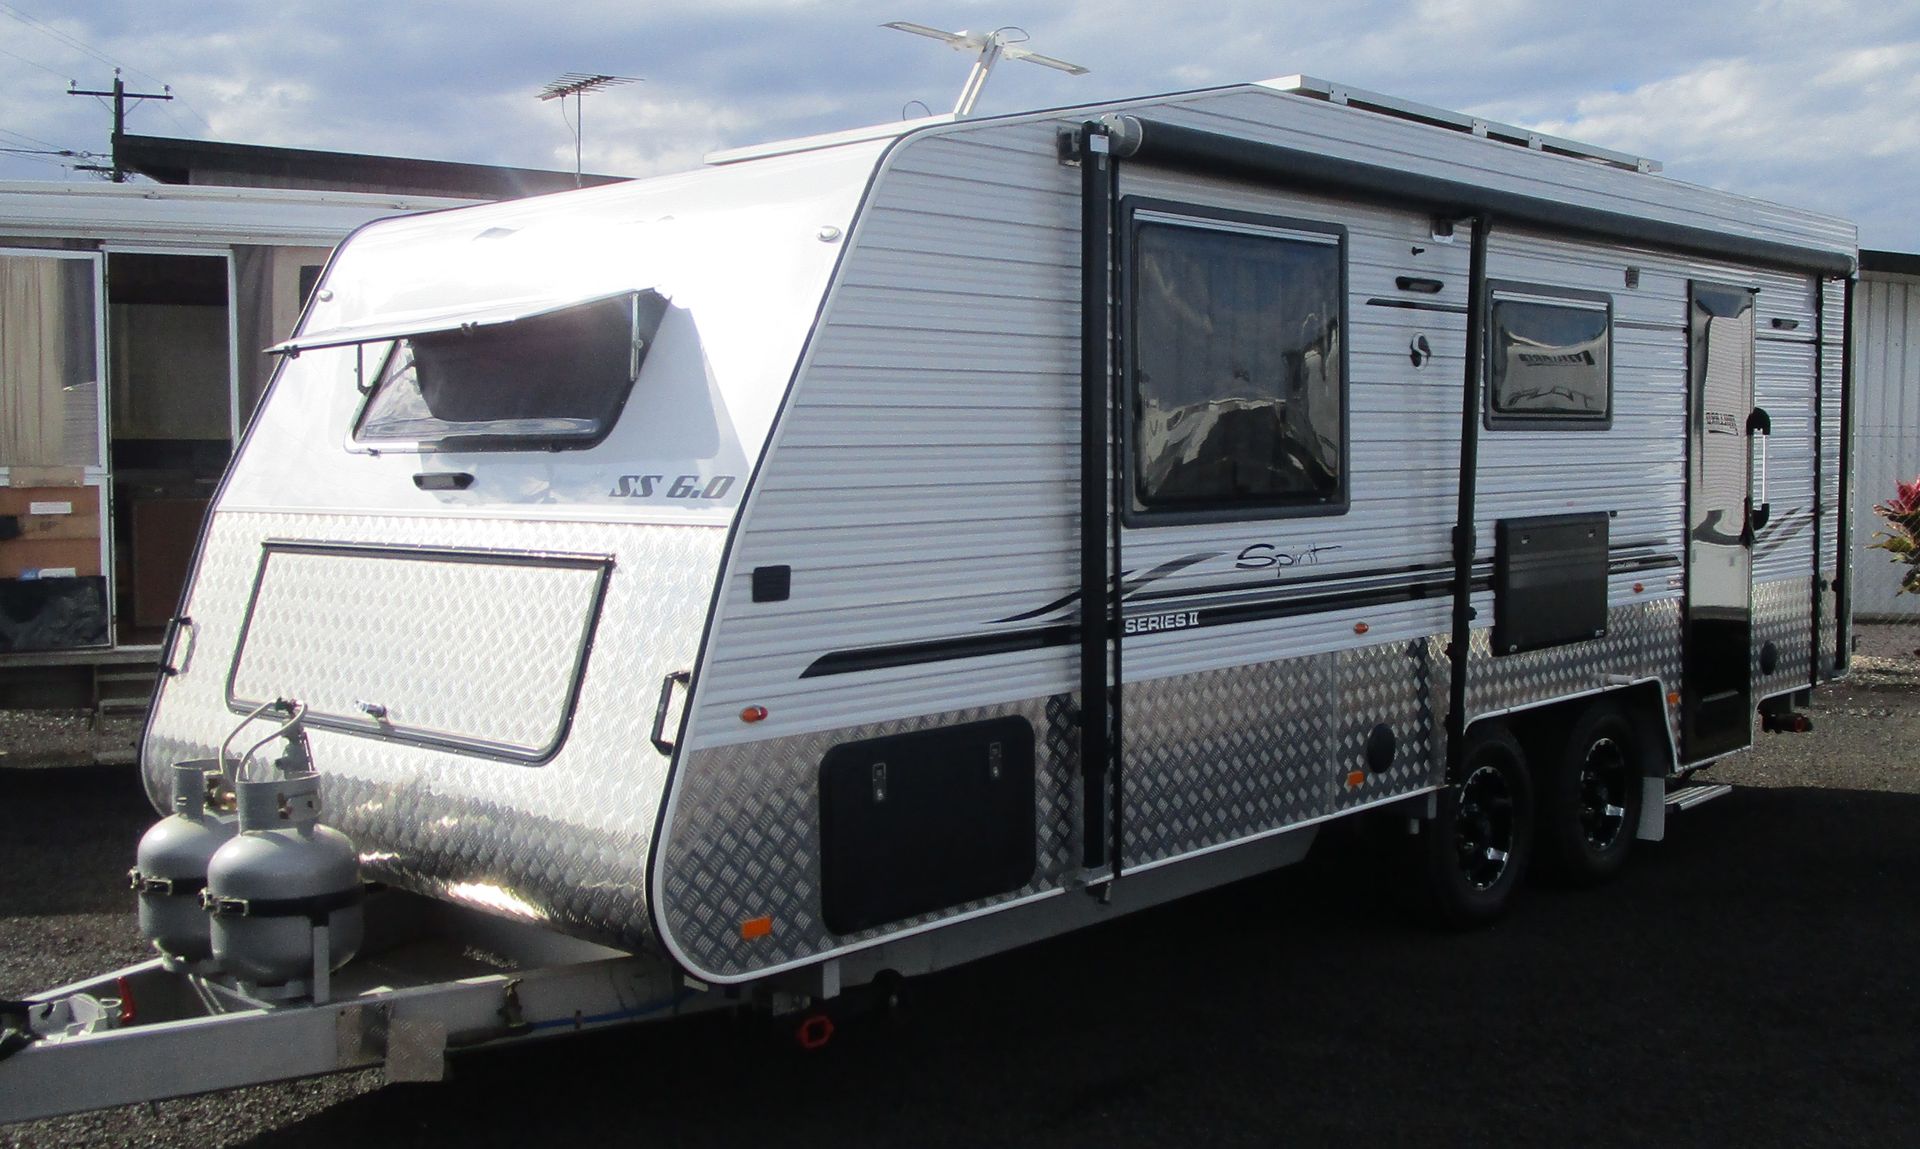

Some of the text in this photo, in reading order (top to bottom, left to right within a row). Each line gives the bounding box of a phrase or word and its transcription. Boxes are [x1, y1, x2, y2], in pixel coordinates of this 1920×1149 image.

[608, 475, 736, 499] SS 6.0
[1235, 543, 1342, 578] Spirit
[1124, 613, 1187, 633] SERIES
